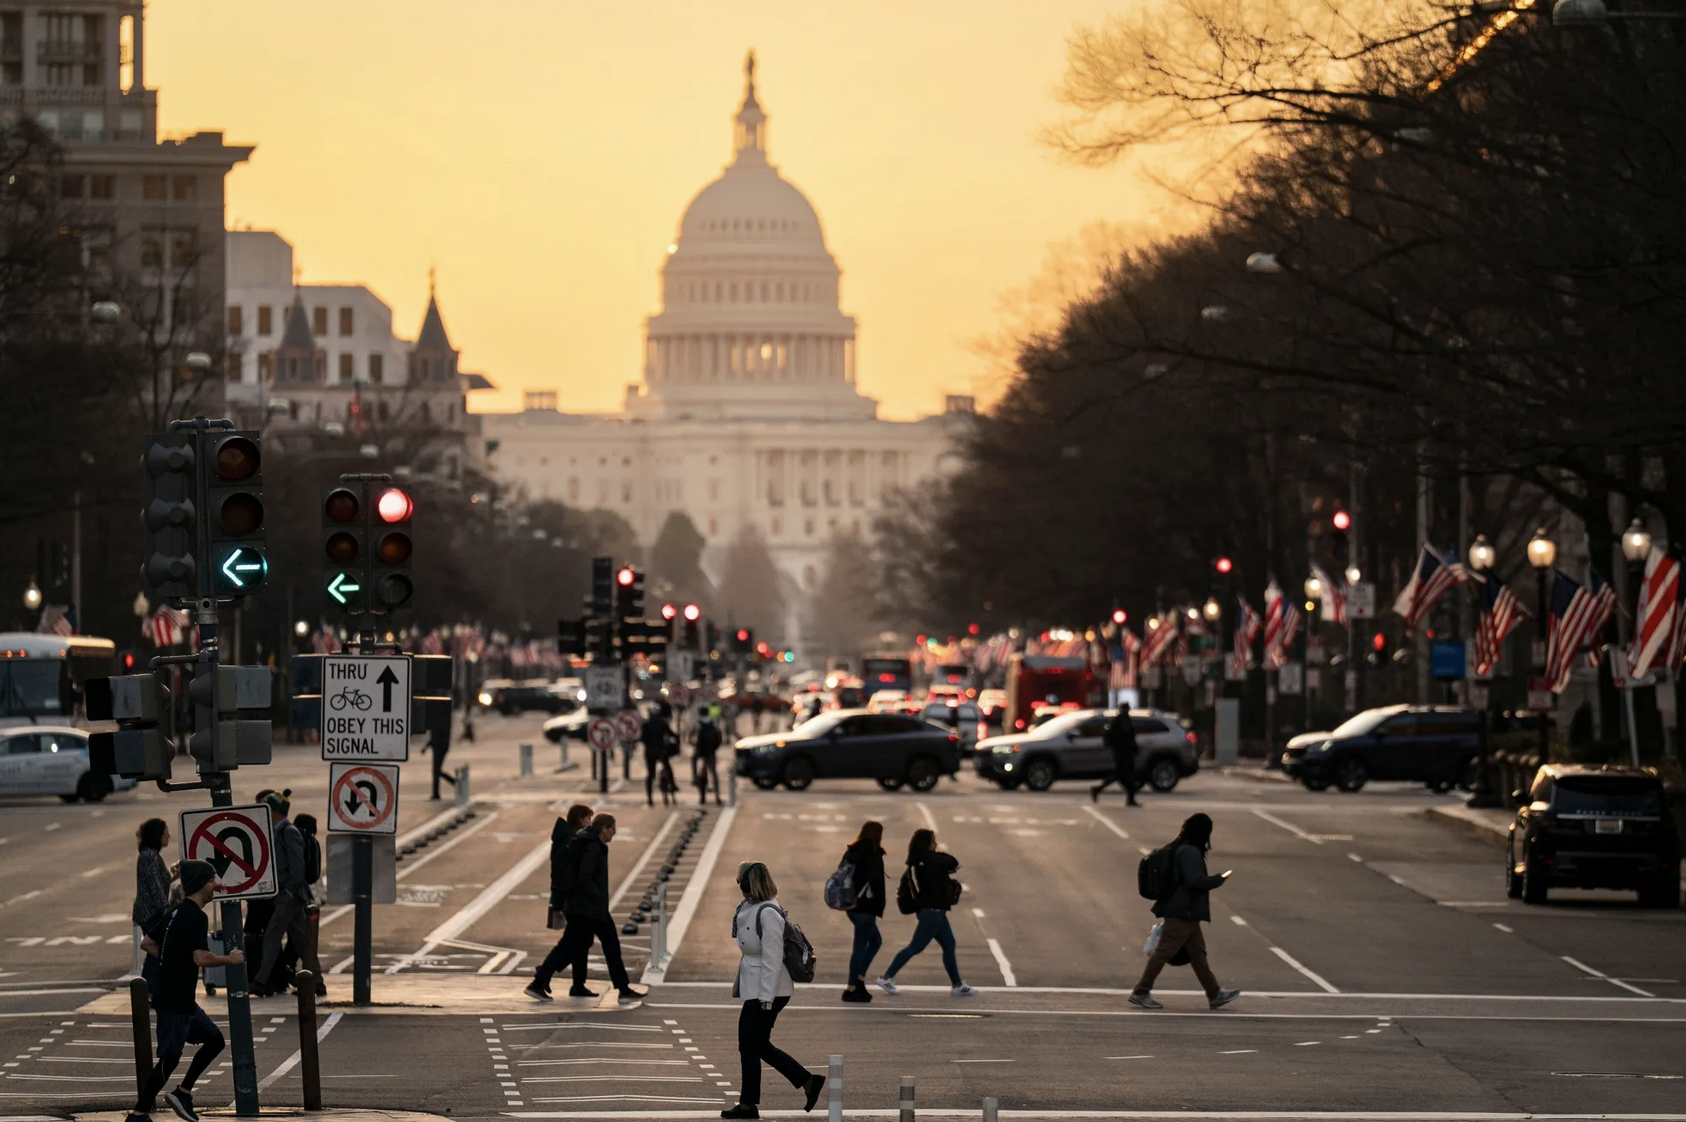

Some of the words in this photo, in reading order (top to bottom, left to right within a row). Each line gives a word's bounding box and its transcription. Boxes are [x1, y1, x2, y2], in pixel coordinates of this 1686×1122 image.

[330, 664, 368, 680] THRU
[327, 718, 366, 734] OBEY
[373, 719, 404, 735] THIS
[327, 738, 379, 754] SIGNAL
